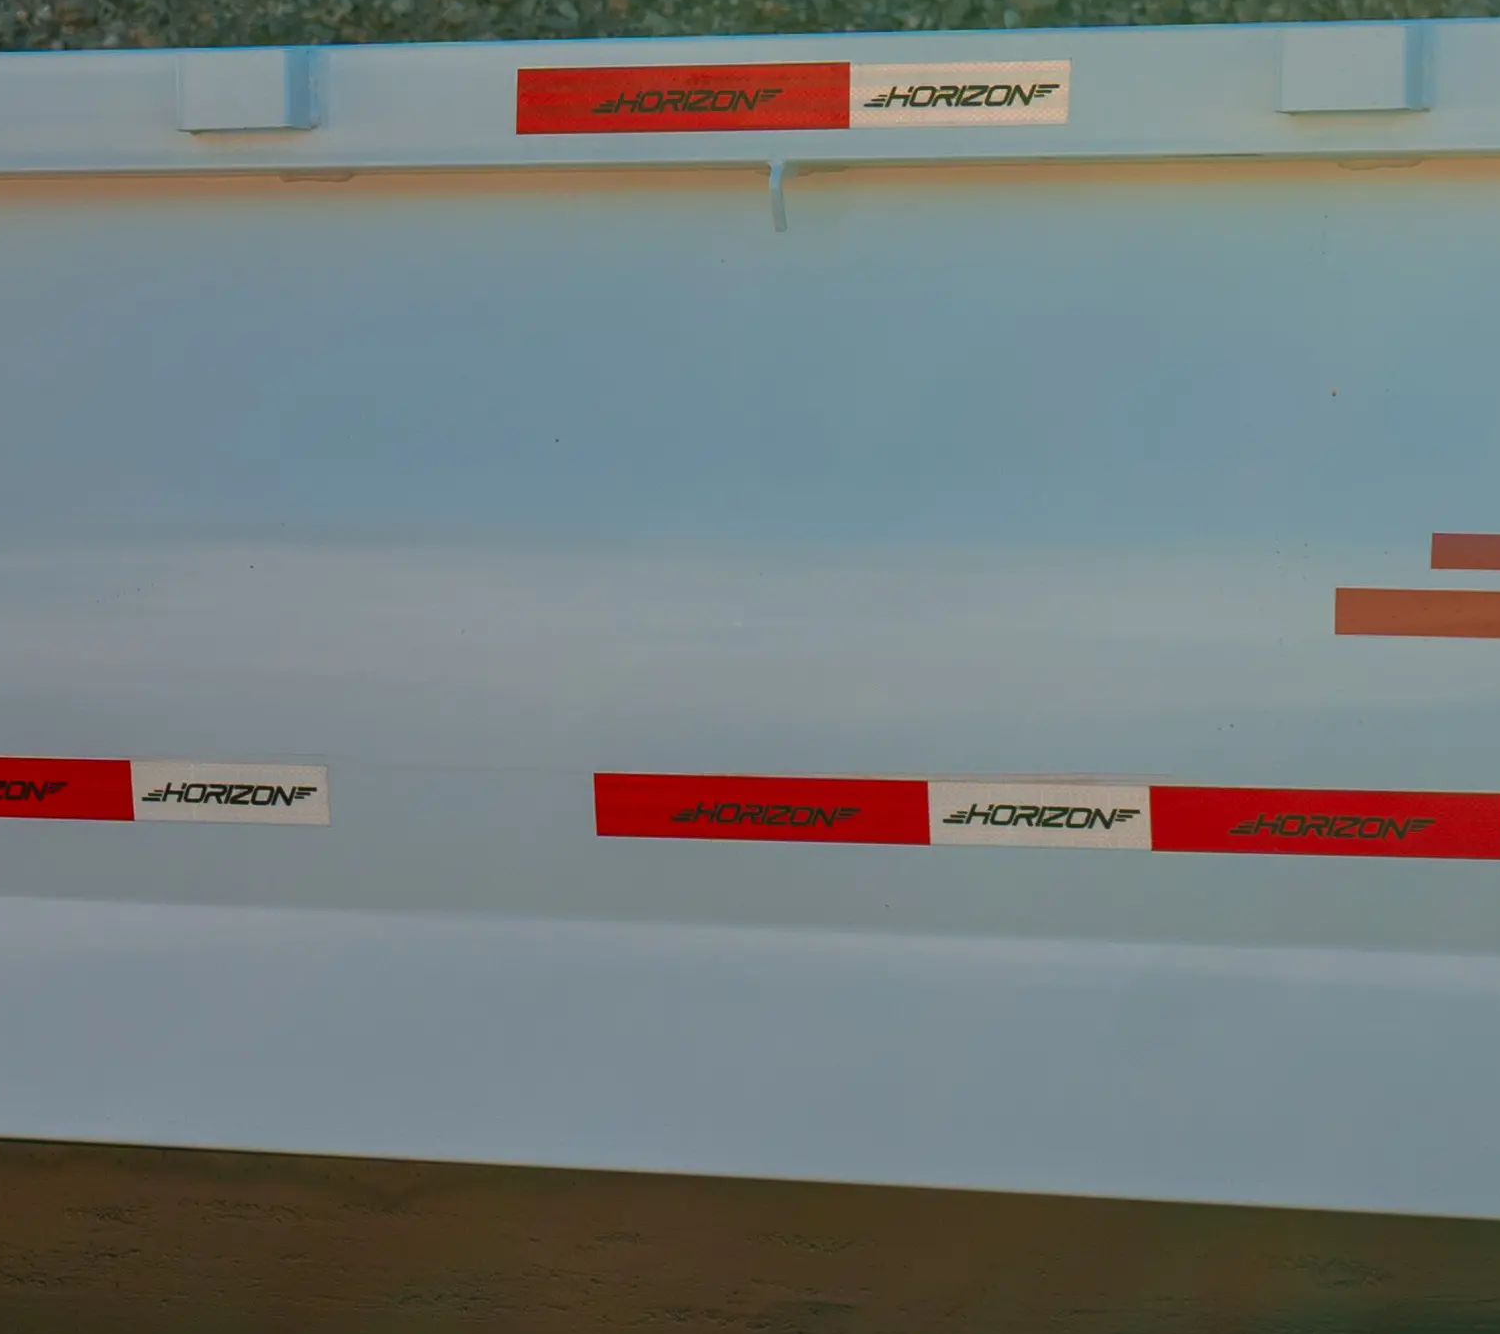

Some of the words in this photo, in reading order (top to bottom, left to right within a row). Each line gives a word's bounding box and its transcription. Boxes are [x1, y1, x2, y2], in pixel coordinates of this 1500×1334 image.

[614, 88, 766, 113] HORIZON
[885, 83, 1040, 108] HORIZON
[160, 782, 300, 807] HORIZON
[691, 801, 841, 828] HORIZON
[965, 803, 1120, 830] HORIZON
[1253, 813, 1416, 840] HORIZON
